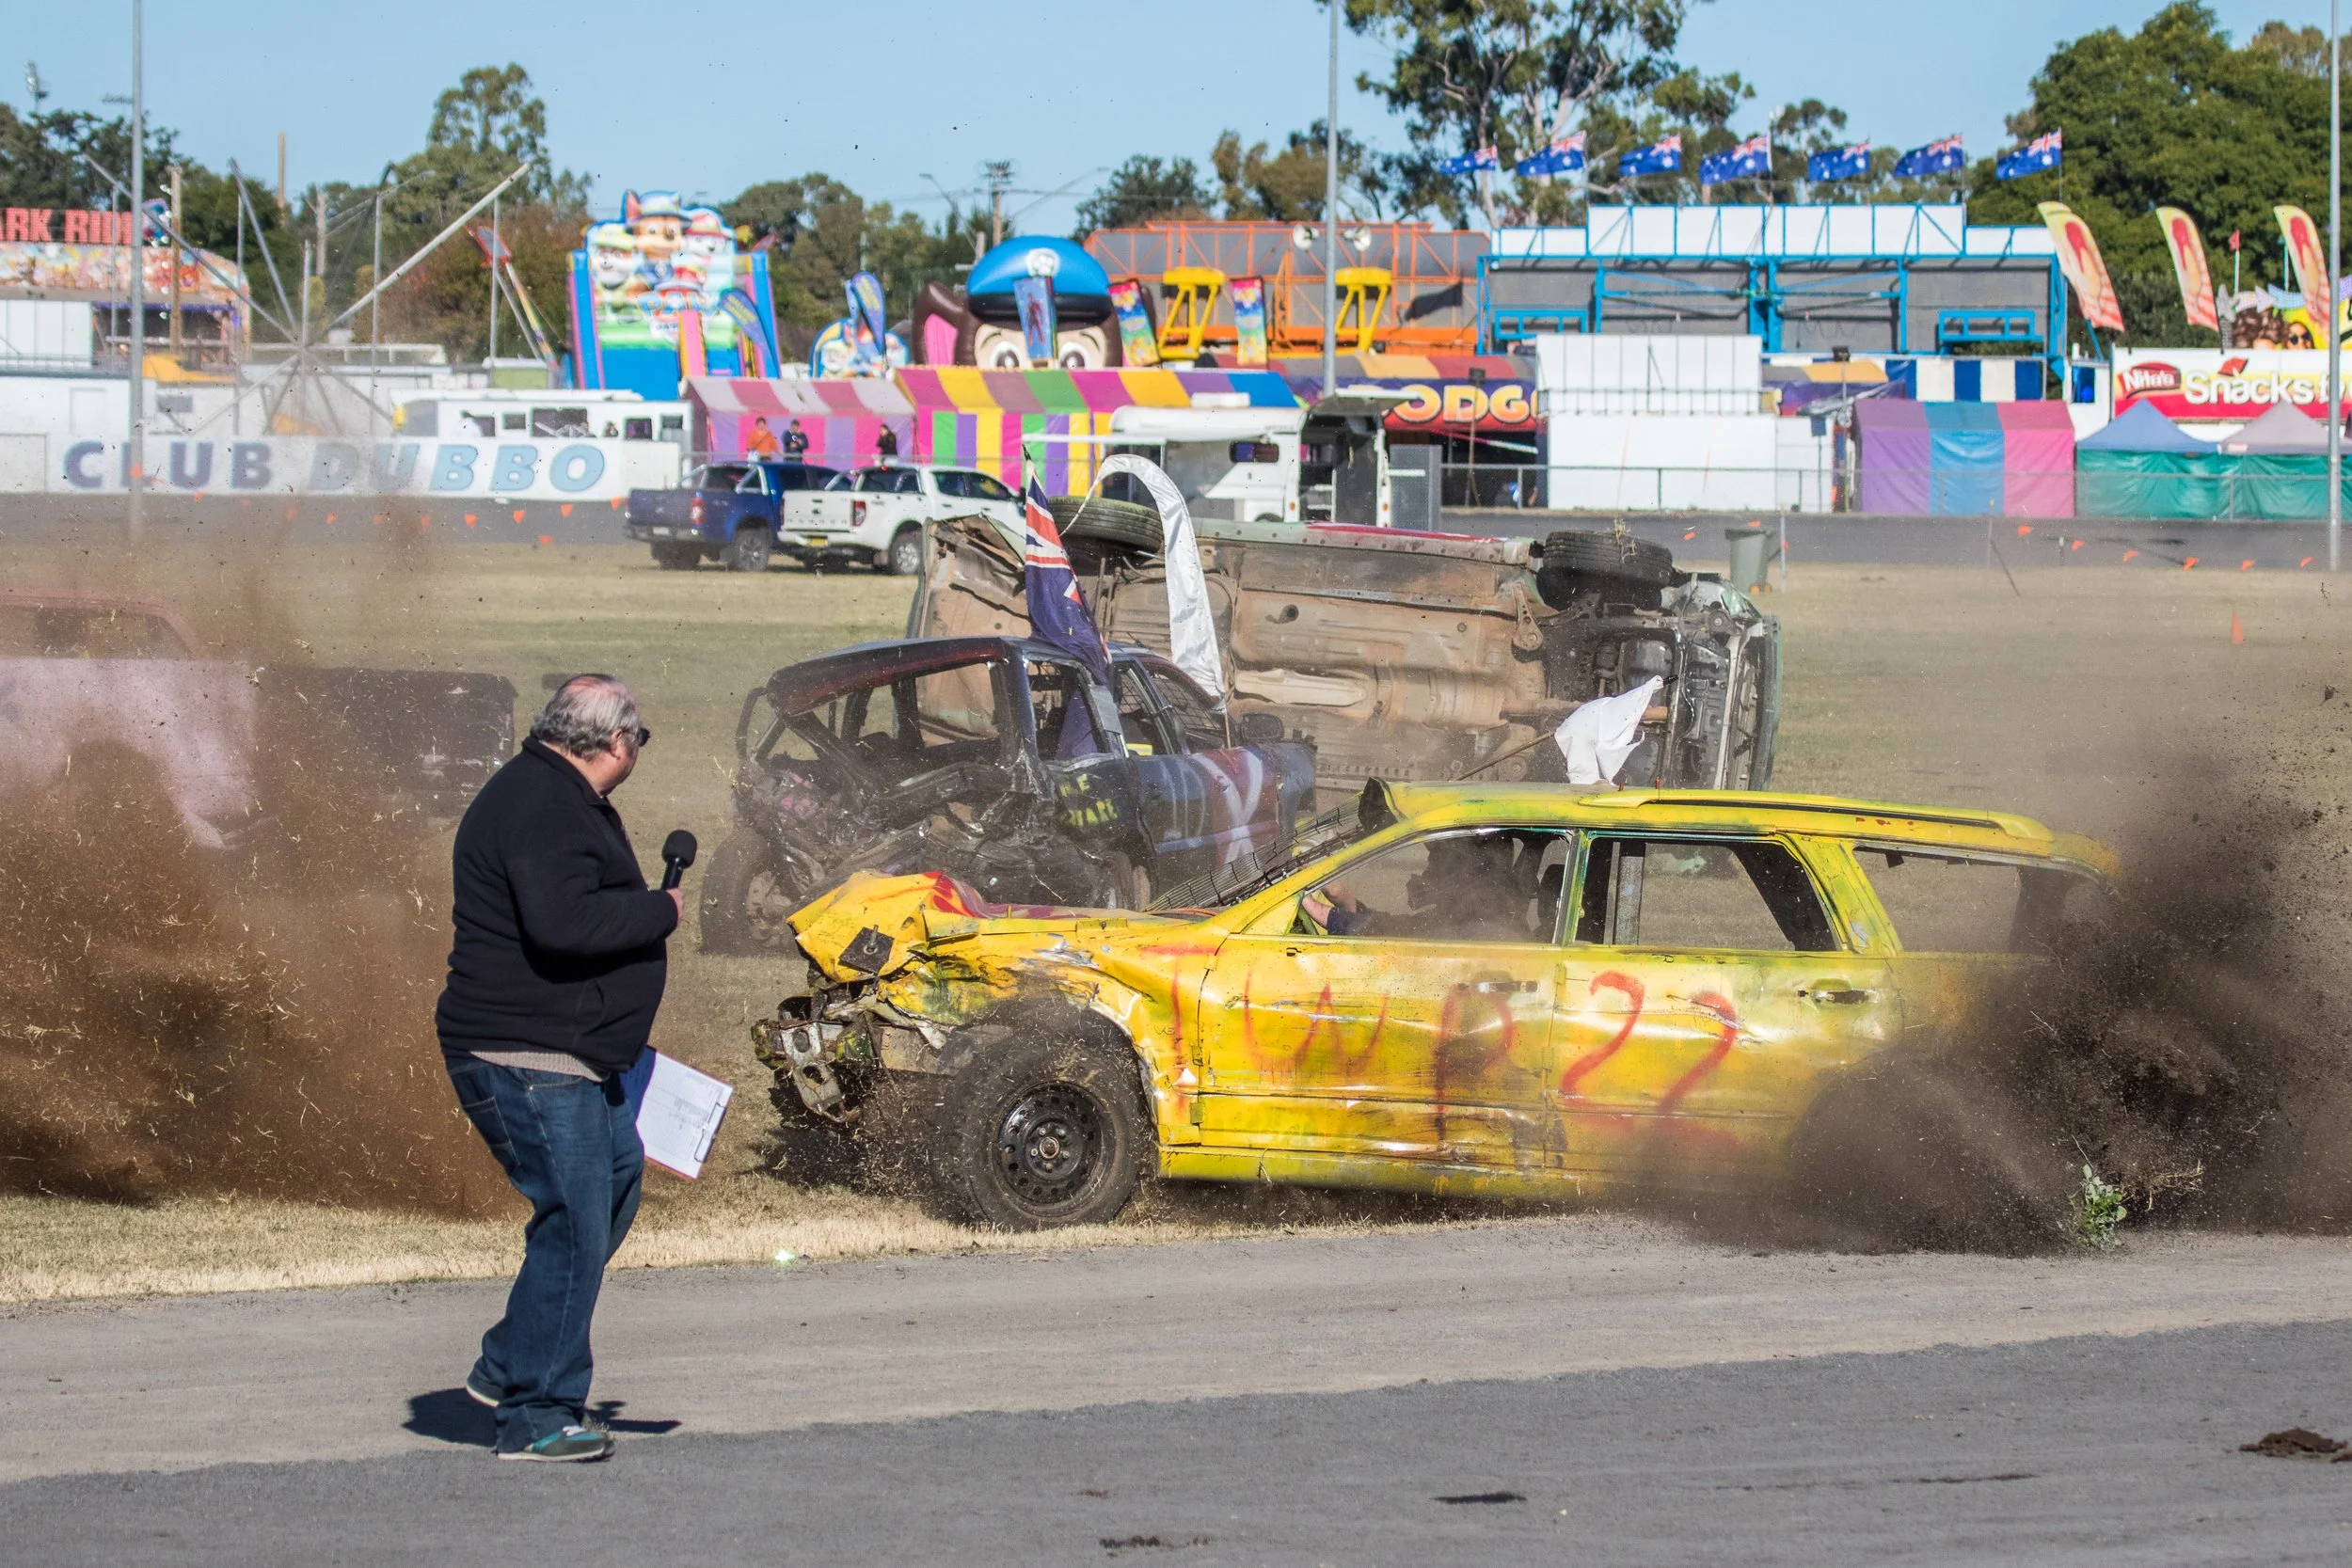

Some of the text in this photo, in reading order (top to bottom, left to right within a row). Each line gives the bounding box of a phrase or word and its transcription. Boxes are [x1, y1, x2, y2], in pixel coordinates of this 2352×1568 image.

[0, 207, 53, 242] RK
[1346, 384, 1540, 422] ODG
[2185, 371, 2314, 405] Snacks
[64, 440, 605, 493] CLUB DUBBO
